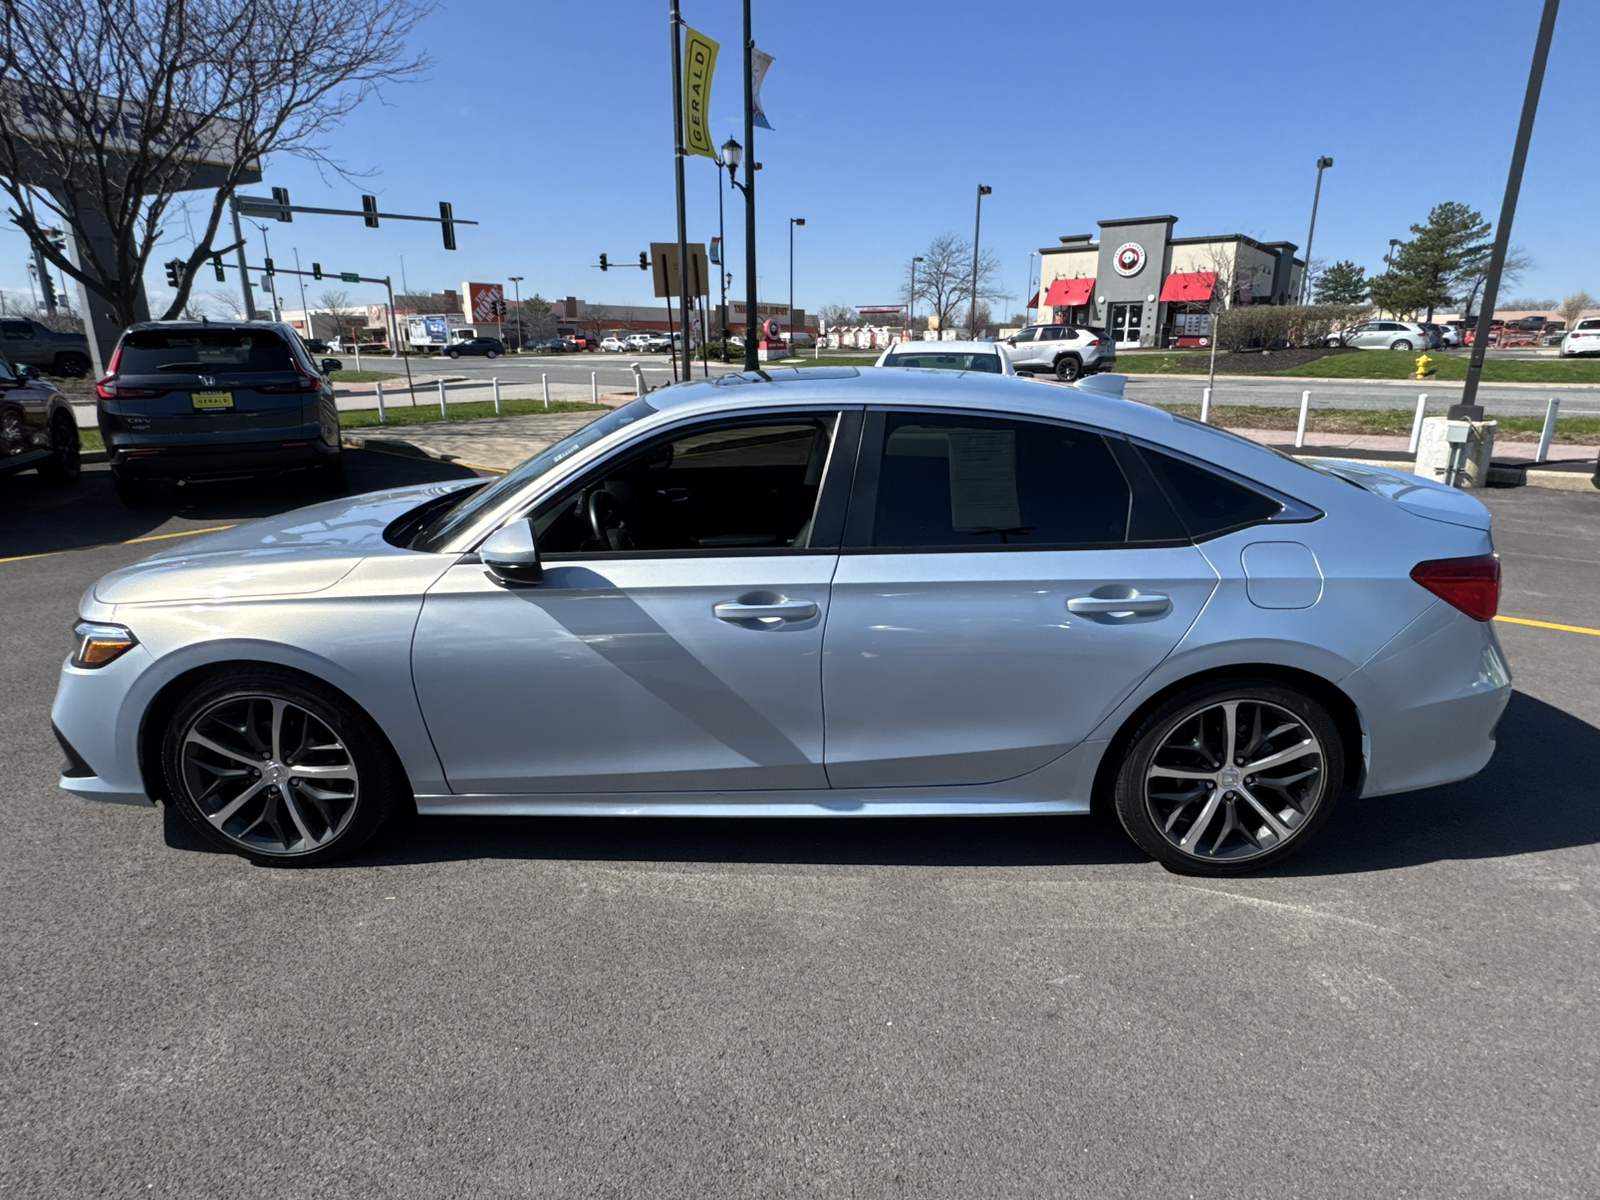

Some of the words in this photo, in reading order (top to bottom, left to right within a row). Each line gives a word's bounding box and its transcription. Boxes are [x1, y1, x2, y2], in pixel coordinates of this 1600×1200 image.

[691, 51, 705, 143] GERALD
[473, 285, 503, 322] HOME
[474, 288, 488, 304] THE
